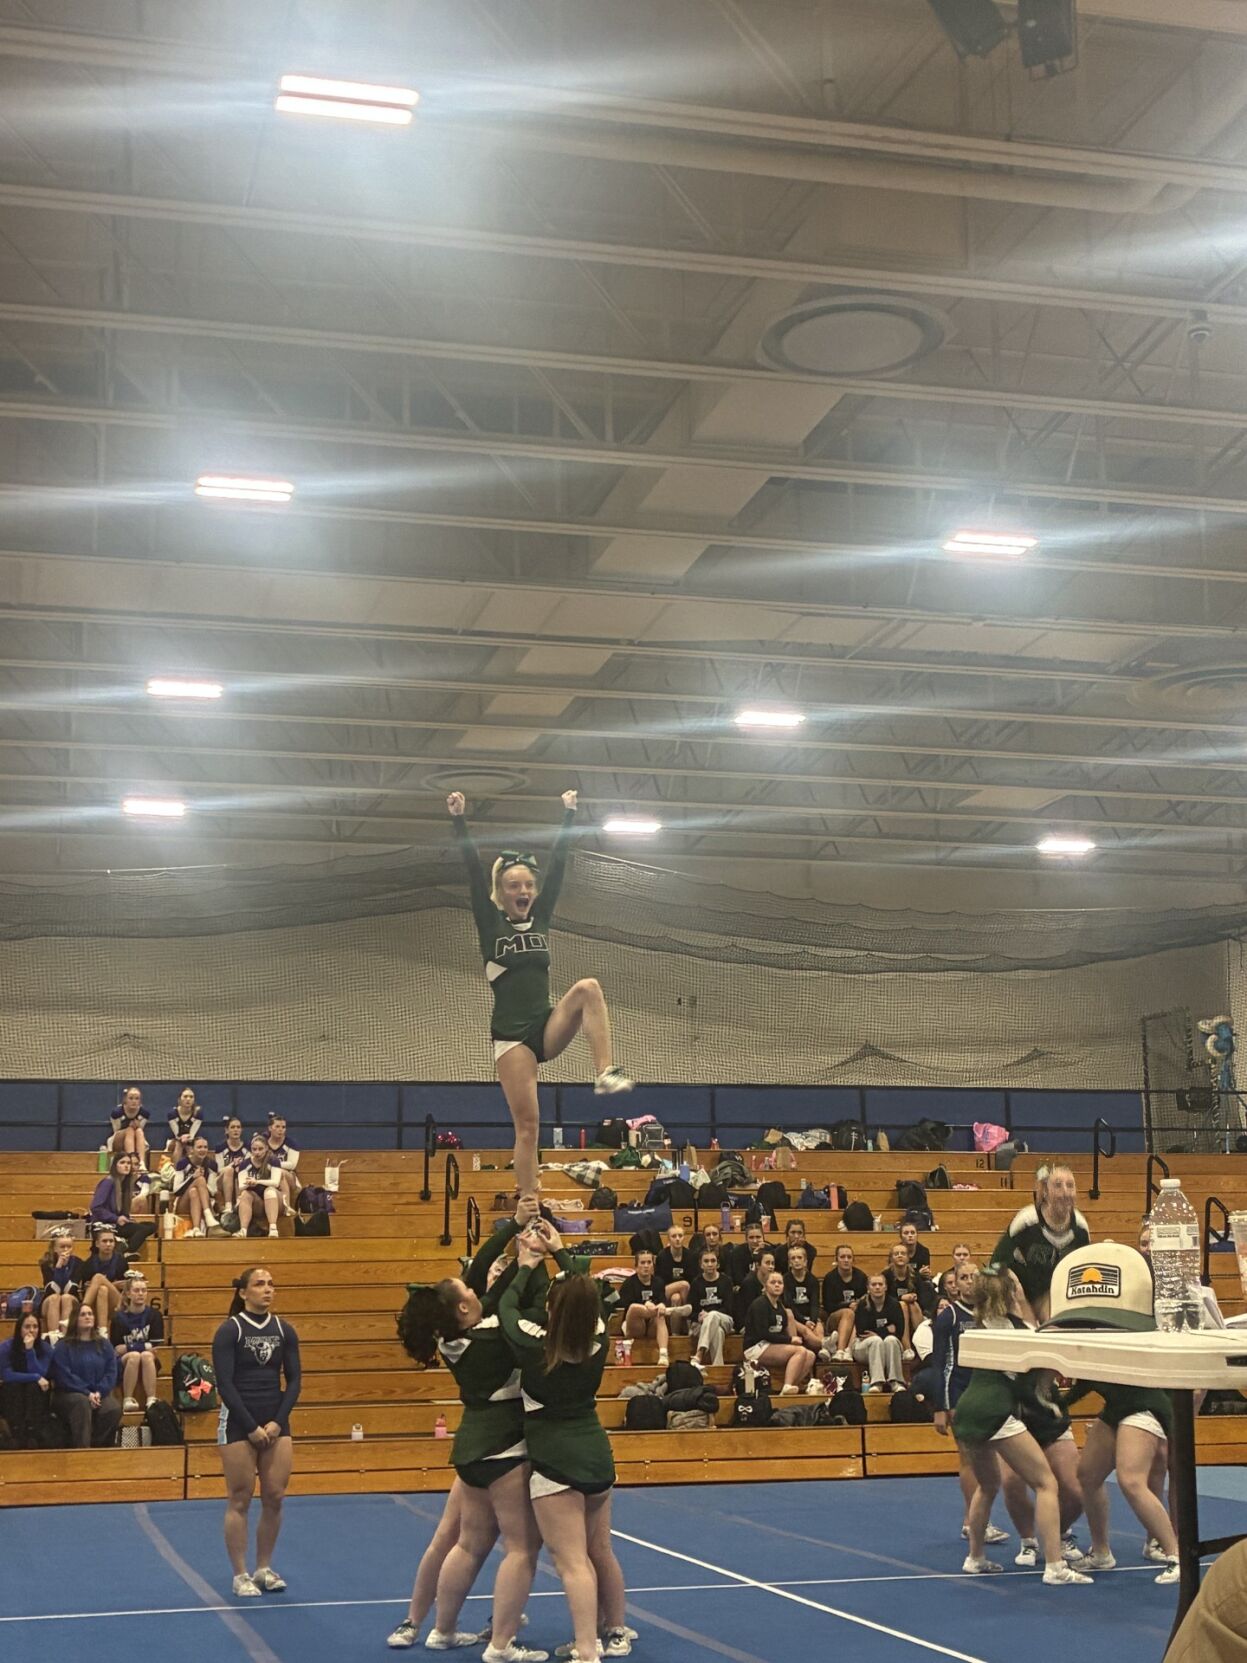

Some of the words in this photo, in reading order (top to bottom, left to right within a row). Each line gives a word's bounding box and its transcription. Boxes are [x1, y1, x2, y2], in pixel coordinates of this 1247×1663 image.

[495, 932, 549, 959] MD
[976, 1158, 985, 1169] 12
[1000, 1176, 1008, 1188] 11
[705, 1286, 718, 1300] E
[1071, 1284, 1115, 1295] Katahdin
[150, 1296, 162, 1310] 6
